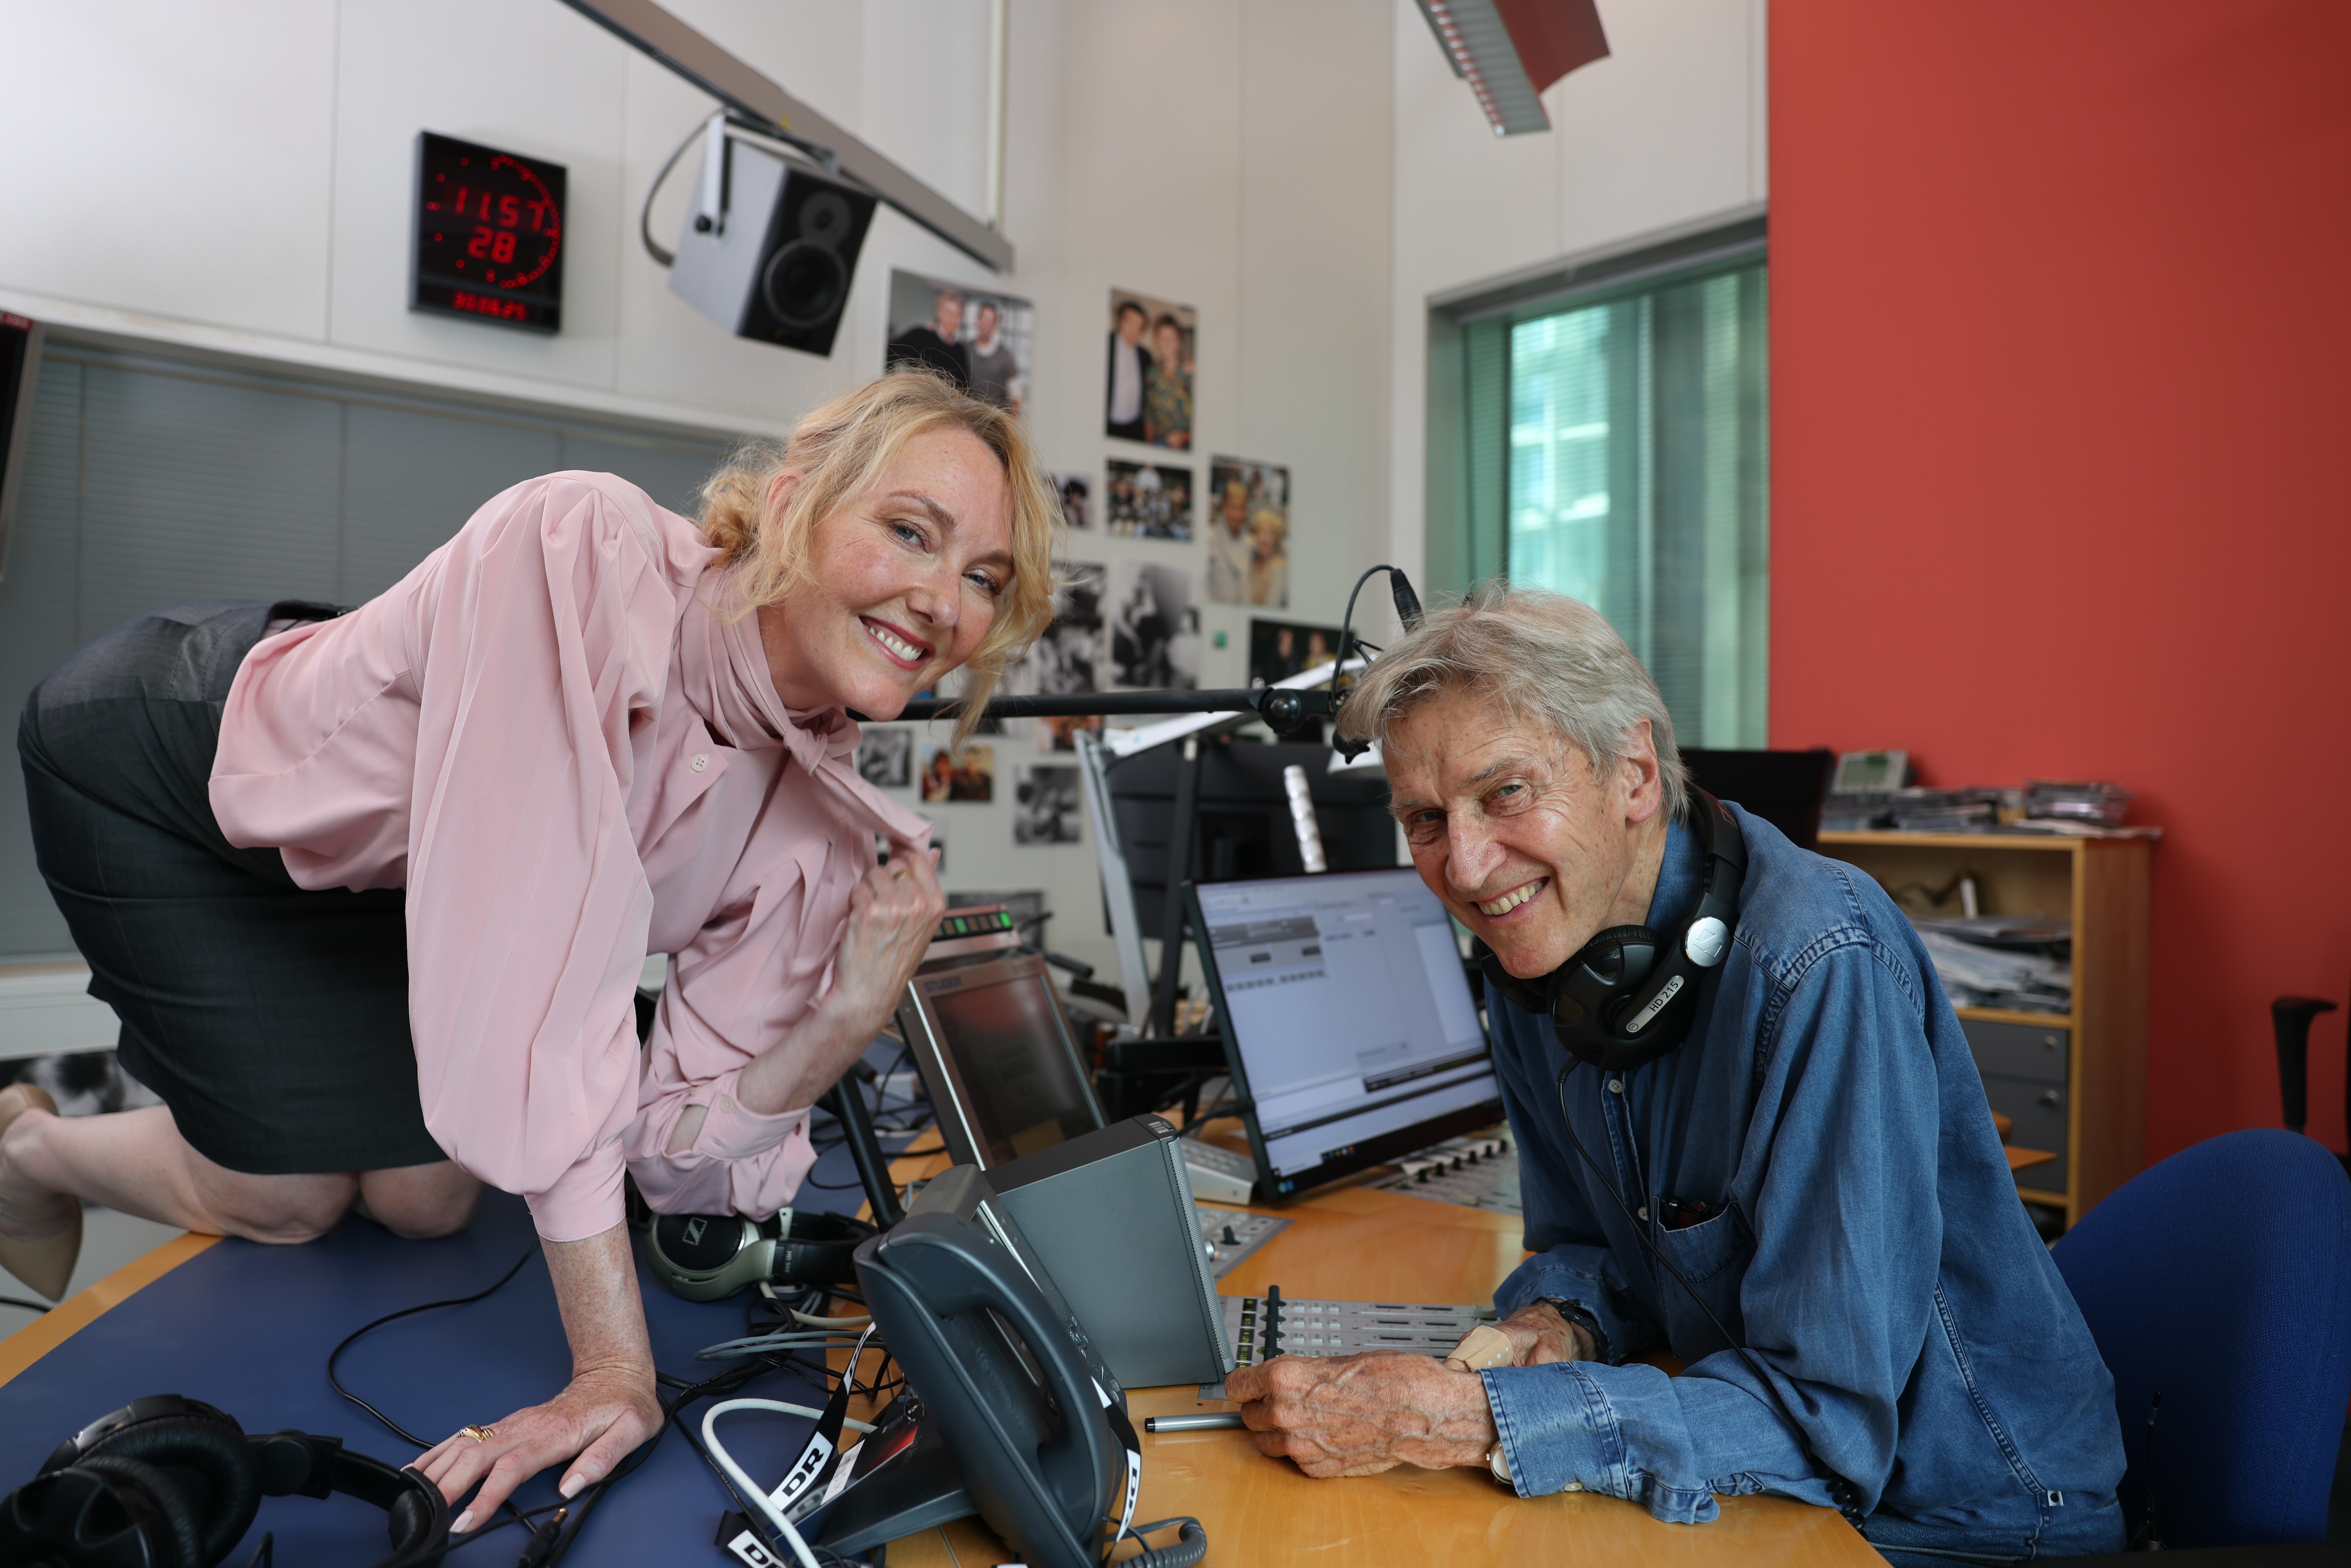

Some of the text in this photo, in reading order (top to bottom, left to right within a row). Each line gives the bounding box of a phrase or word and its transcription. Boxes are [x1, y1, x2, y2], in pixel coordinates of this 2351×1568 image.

[468, 225, 516, 264] 28
[1649, 981, 1679, 1012] HD 215
[786, 1251, 792, 1261] HD
[782, 1448, 824, 1497] DR
